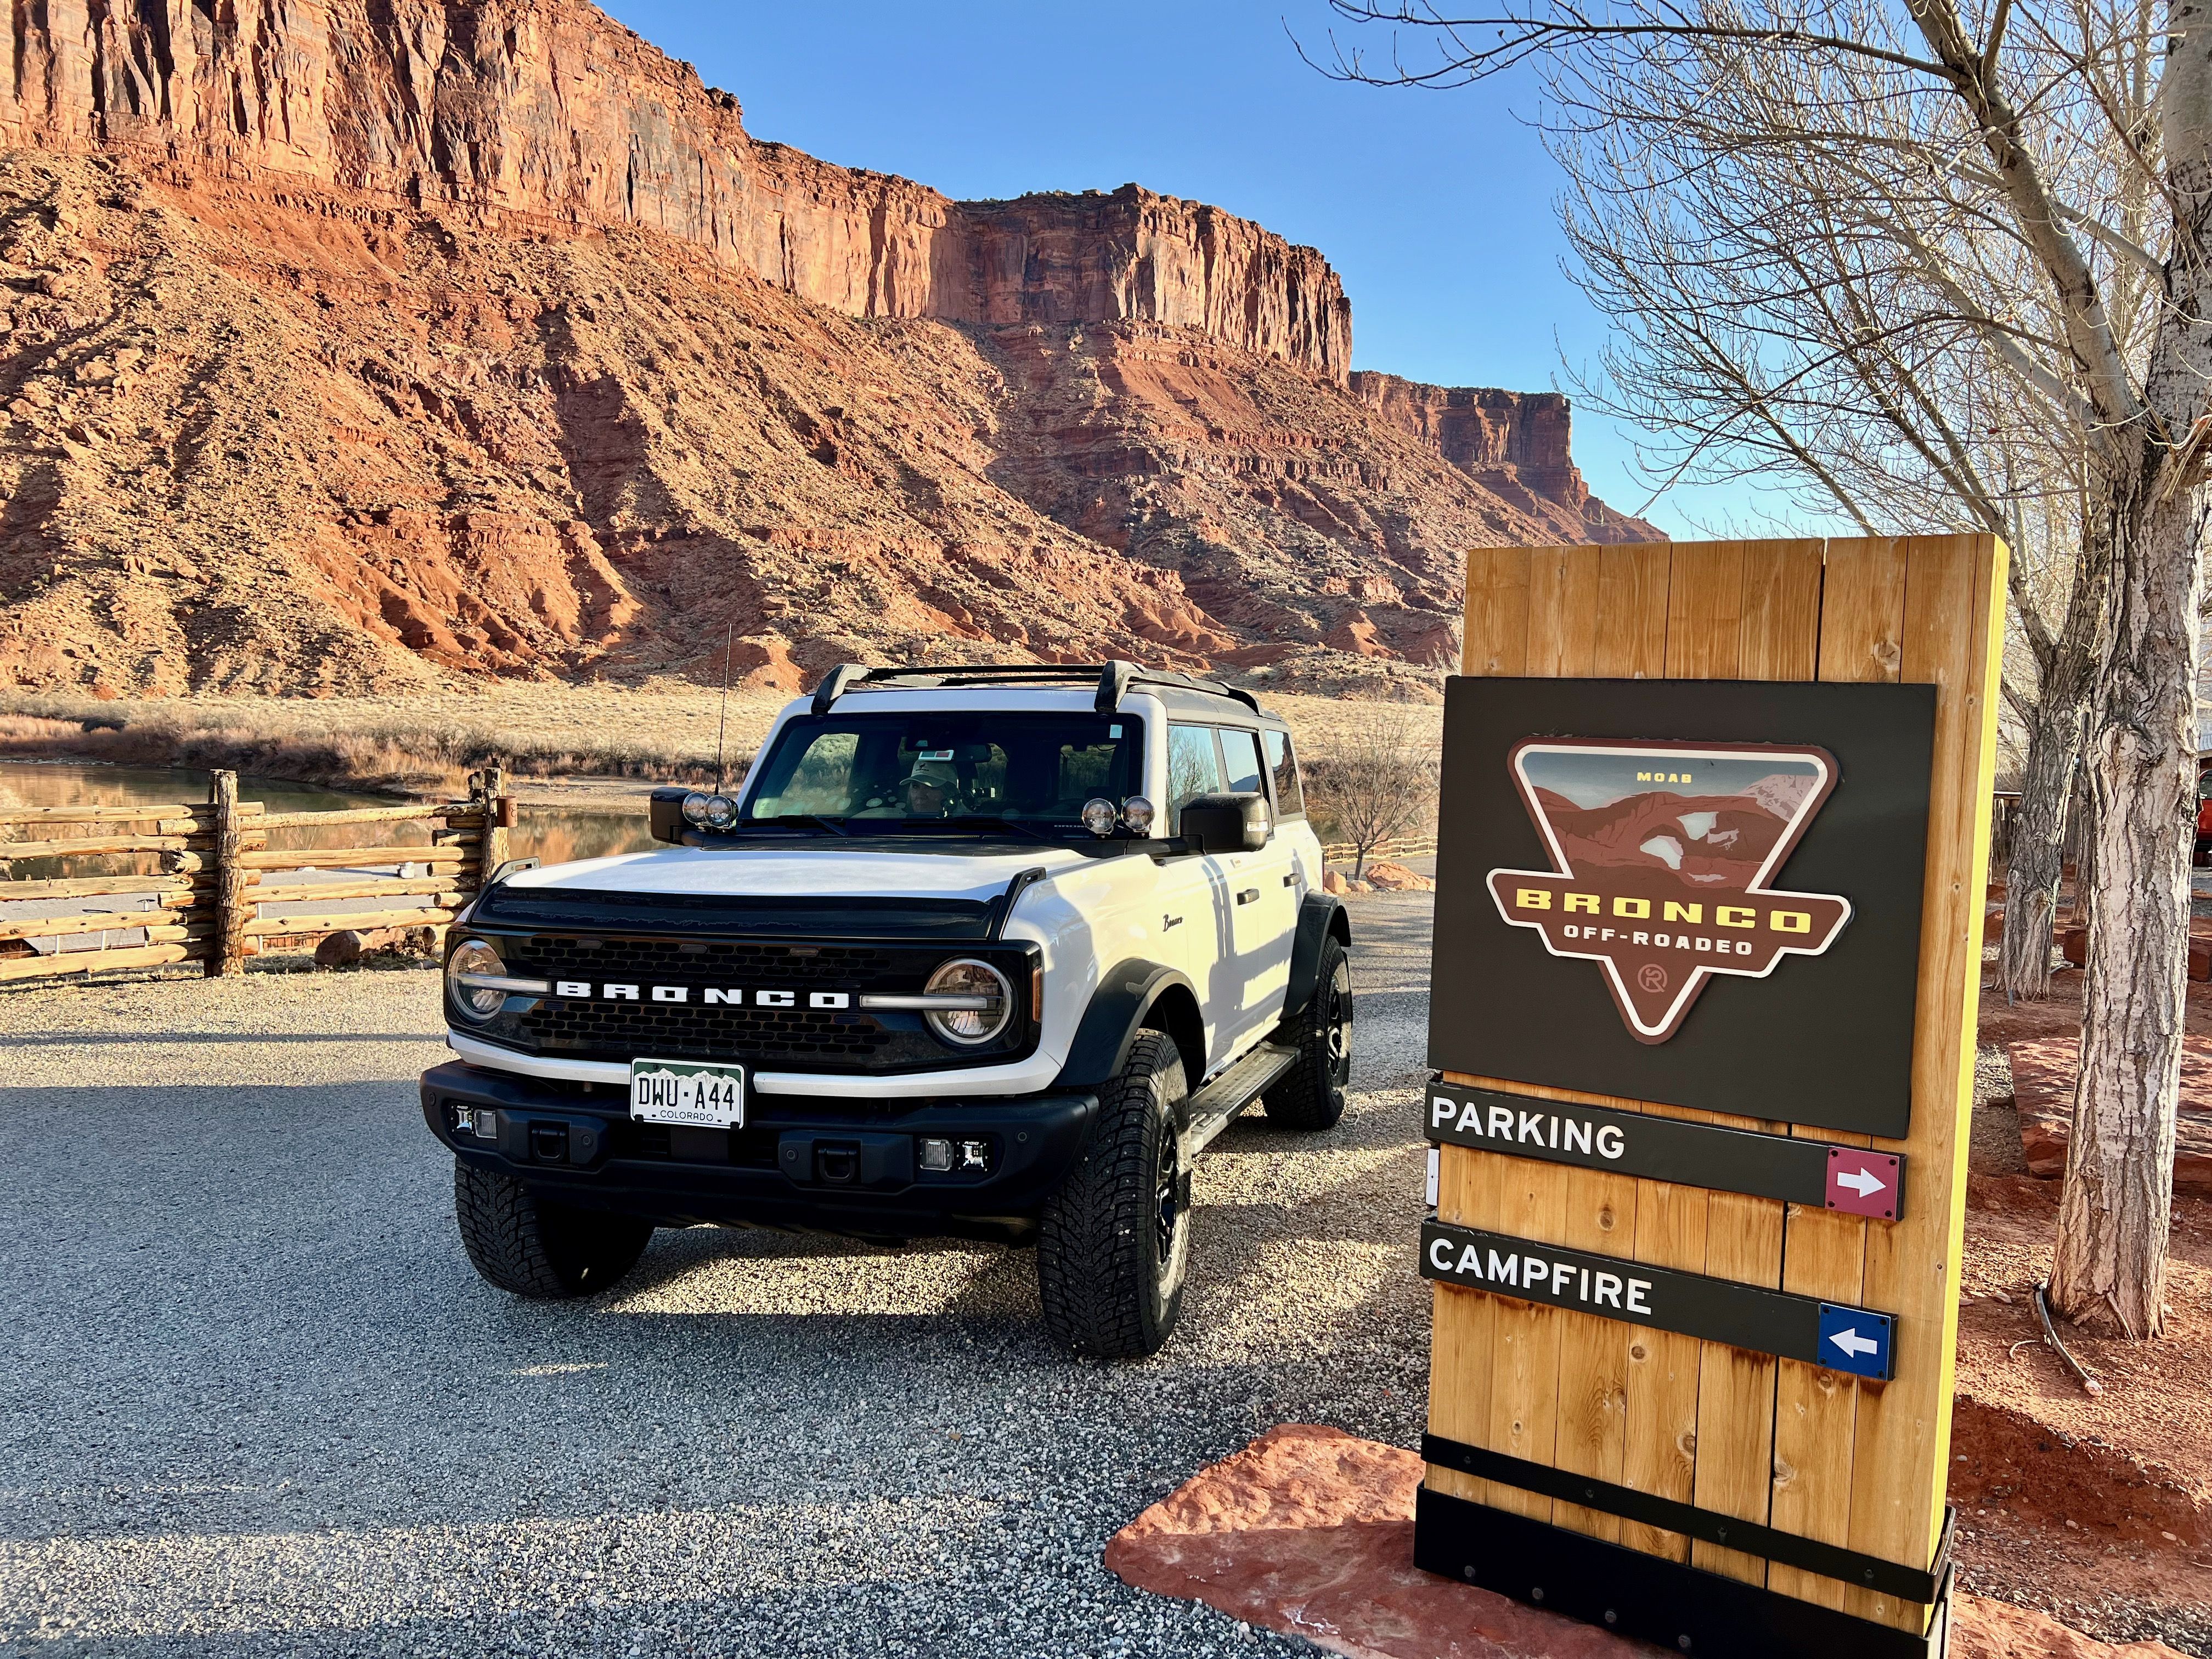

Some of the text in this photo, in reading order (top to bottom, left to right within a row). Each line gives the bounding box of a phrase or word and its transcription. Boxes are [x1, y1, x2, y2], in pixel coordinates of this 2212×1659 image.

[1637, 771, 1692, 784] MOAB
[1516, 888, 1812, 934] BRONCO
[1563, 924, 1753, 956] OFF-ROADEO
[555, 980, 851, 1009] BRONCO
[660, 1110, 713, 1121] COLORADO
[1431, 1096, 1626, 1160] PARKING
[1429, 1238, 1653, 1316] CAMPFIRE
